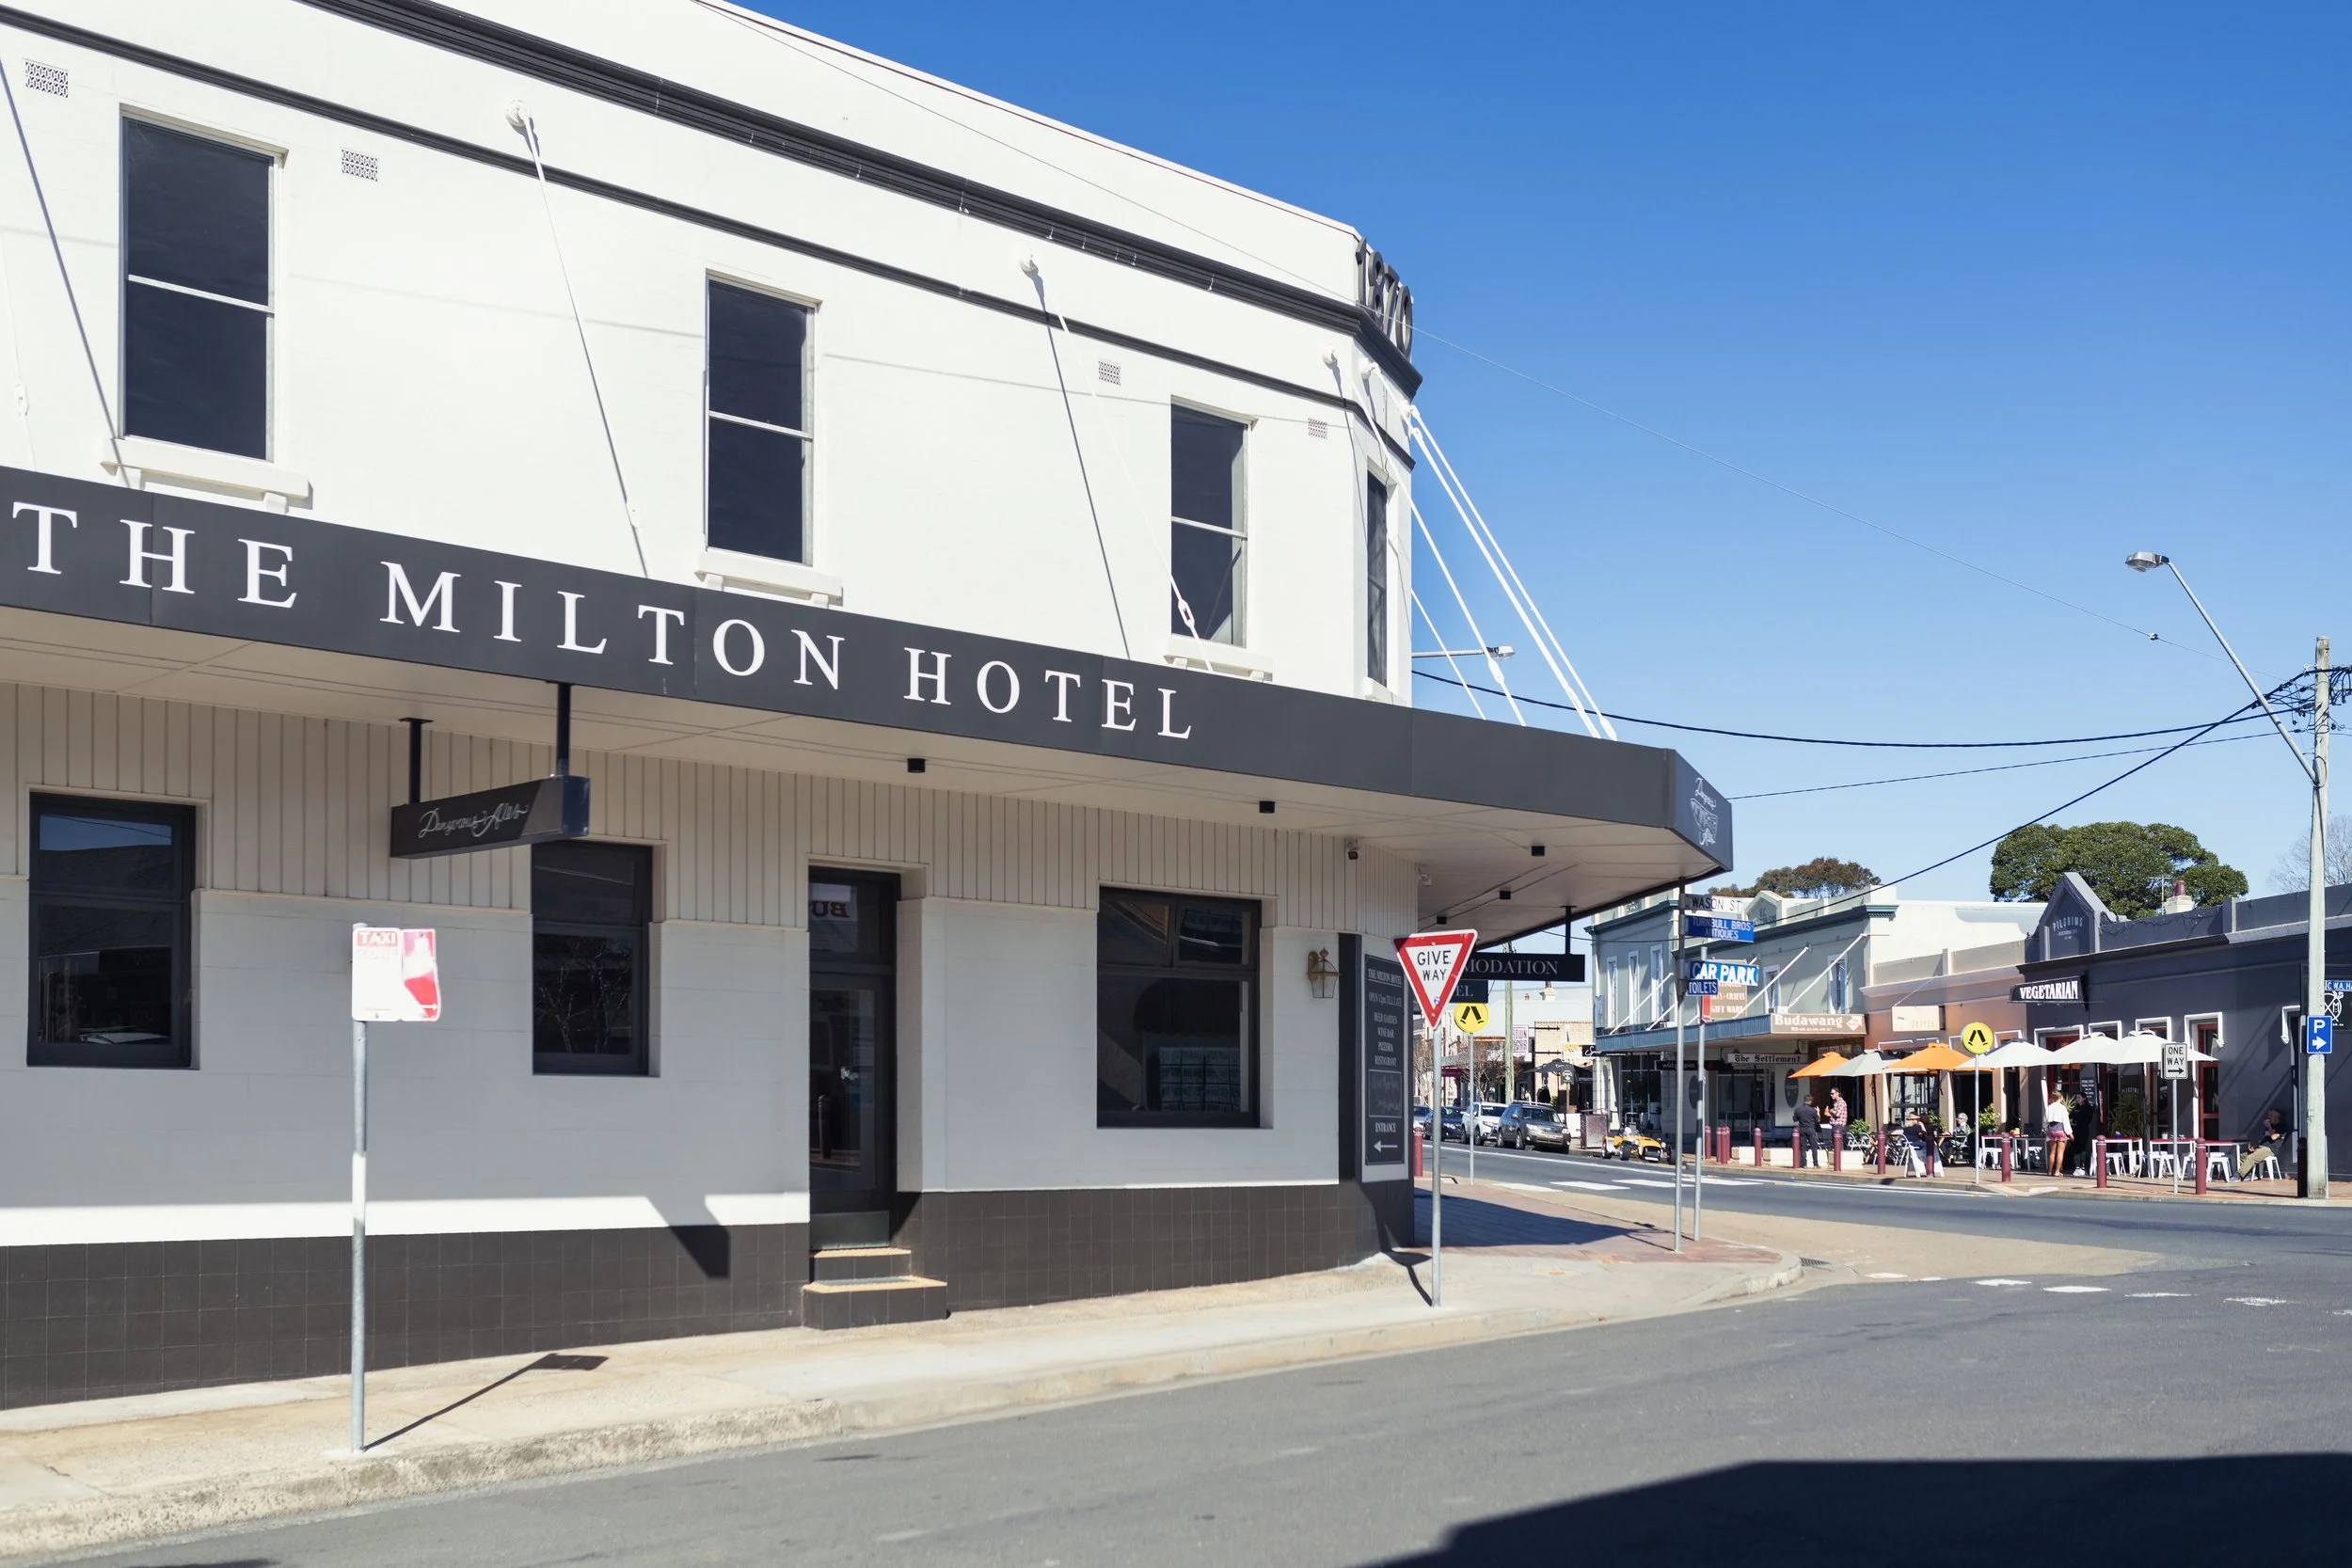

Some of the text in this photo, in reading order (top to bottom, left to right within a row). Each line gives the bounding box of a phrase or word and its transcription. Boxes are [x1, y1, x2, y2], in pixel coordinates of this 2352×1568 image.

[1356, 237, 1413, 359] 1870
[12, 500, 1192, 739] THE MILTON HOTEL
[1692, 895, 1741, 911] WASON ST
[2052, 916, 2084, 931] PILGRIMS
[358, 931, 396, 945] TAXI
[1417, 950, 1451, 965] GIVE
[1464, 958, 1558, 974] MODATION
[1422, 970, 1446, 981] WAY
[1692, 962, 1757, 986] CAR PARK
[1689, 981, 1717, 994] TOILETS
[2020, 980, 2078, 999] VEGETARIAN
[1374, 1012, 1397, 1025] BEER GARDEN
[1774, 1015, 1843, 1029] Budawang
[1377, 1027, 1387, 1037] WINE
[2314, 1019, 2326, 1034] P
[1375, 1054, 1397, 1067] RESTAURANT
[1735, 1054, 1802, 1063] The Settlement
[2167, 1057, 2184, 1066] WAY
[1375, 1122, 1396, 1133] ENTRANCE
